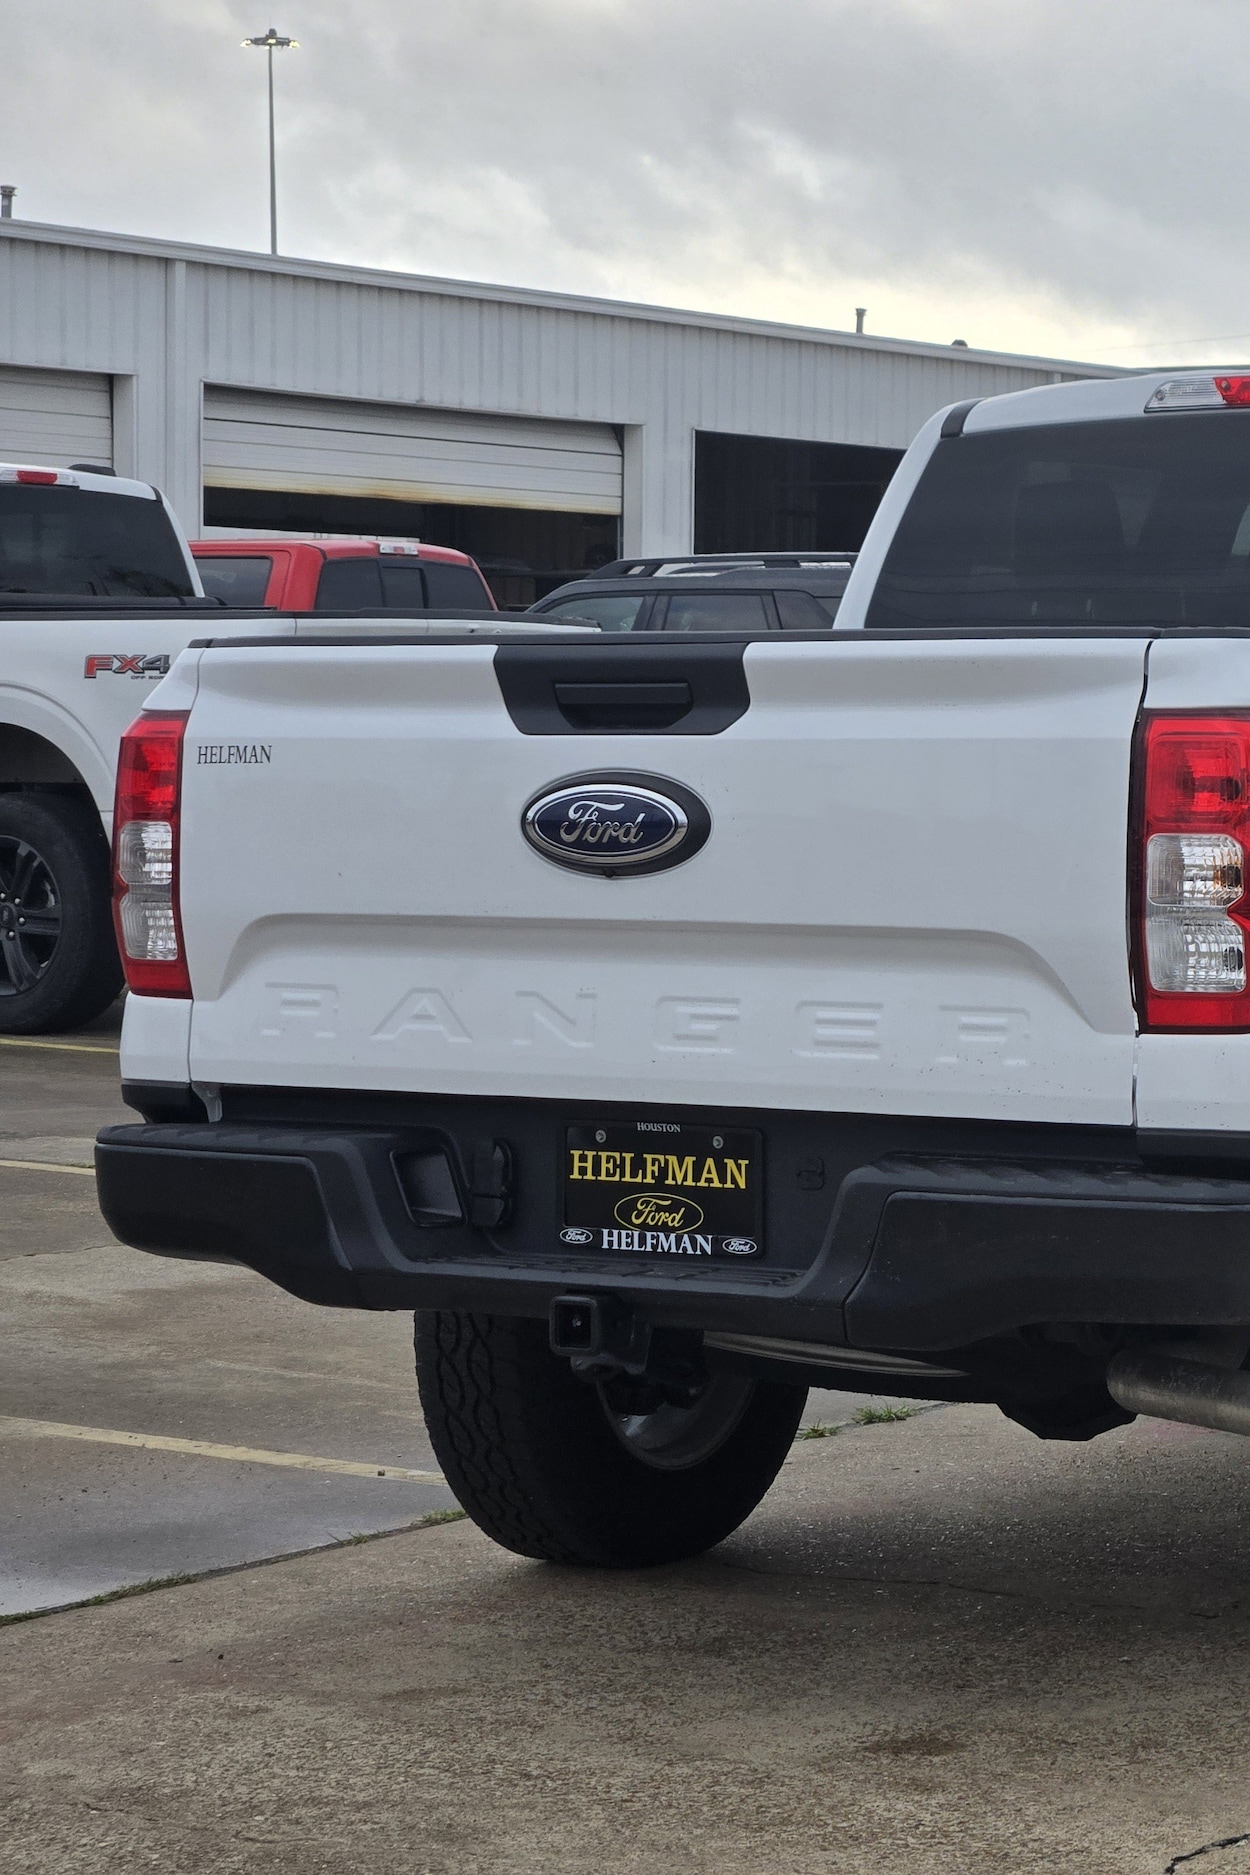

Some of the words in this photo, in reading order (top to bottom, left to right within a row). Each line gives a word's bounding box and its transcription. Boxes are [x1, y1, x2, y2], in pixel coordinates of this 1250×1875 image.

[84, 654, 170, 678] FX4
[196, 744, 273, 765] HELFMAN
[559, 800, 646, 845] Ford
[259, 980, 1032, 1068] RANGER
[636, 1121, 681, 1133] HOUSTON
[569, 1150, 749, 1189] HELFMAN
[631, 1198, 685, 1227] Ford
[565, 1229, 588, 1242] Ford
[601, 1228, 713, 1255] HELFMAN
[728, 1239, 752, 1252] Ford
